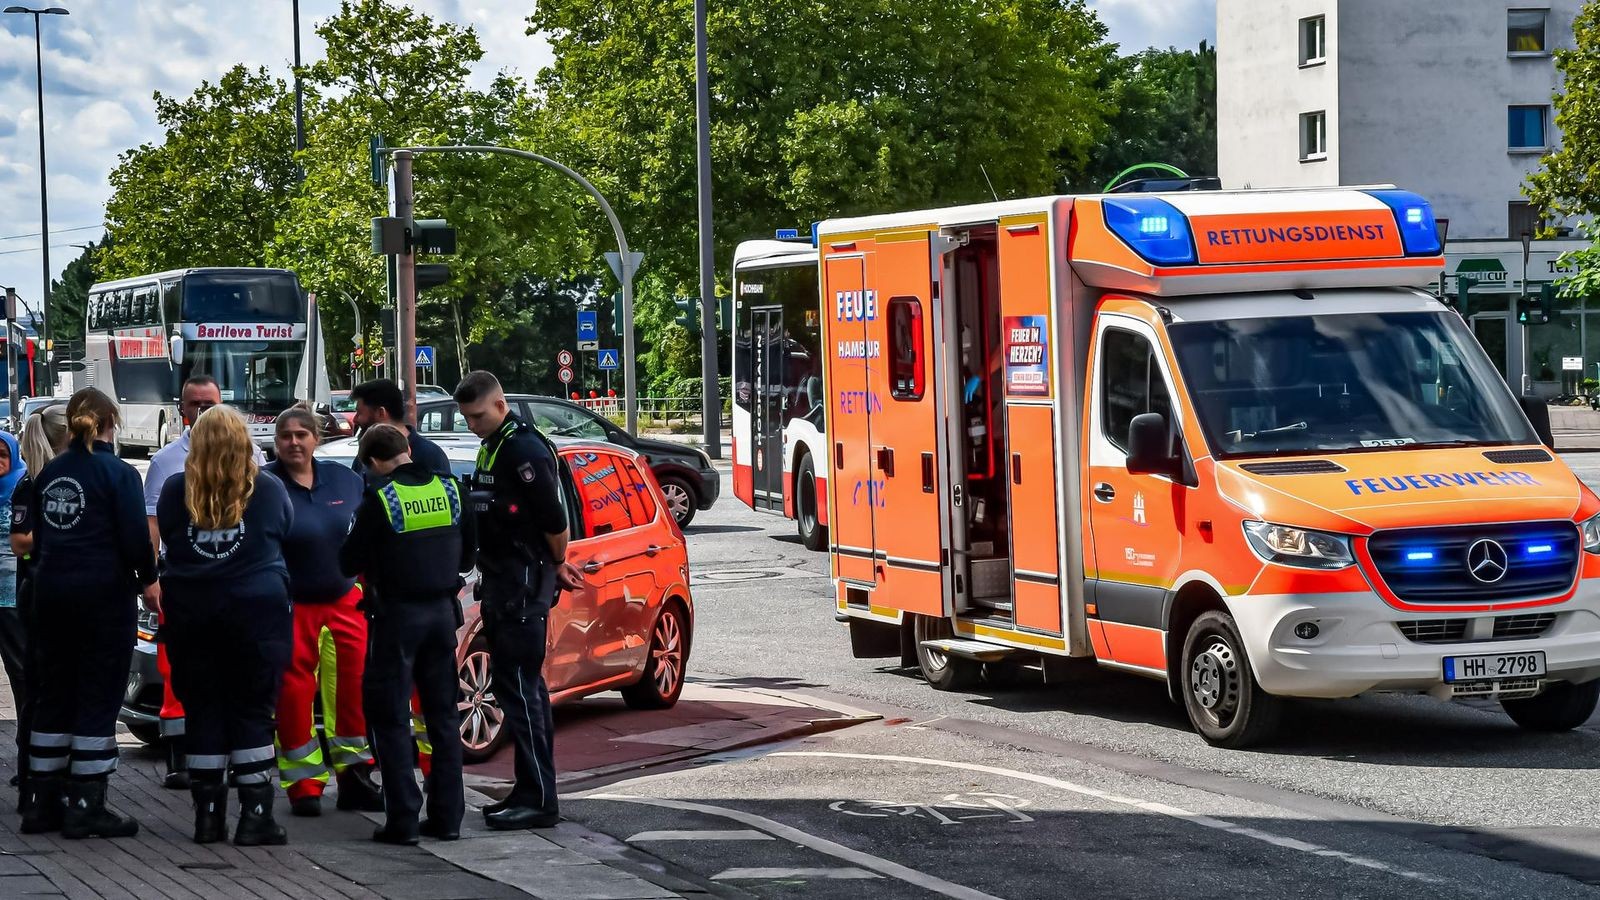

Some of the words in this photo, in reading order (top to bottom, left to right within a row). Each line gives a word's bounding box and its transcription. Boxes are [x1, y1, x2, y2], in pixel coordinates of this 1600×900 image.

[1207, 224, 1385, 246] RETTUNGSDIENST
[836, 290, 878, 321] FEUE
[1012, 328, 1030, 342] FEUER
[1031, 328, 1039, 342] IM
[838, 340, 880, 358] HAMBUR
[1010, 346, 1043, 362] HERZEN?
[840, 392, 882, 414] RETTUN
[1345, 471, 1542, 496] FEUERWEHR
[46, 500, 80, 514] DKT
[404, 496, 447, 516] POLIZEI
[1464, 659, 1486, 676] HH
[1498, 656, 1537, 674] 2798
